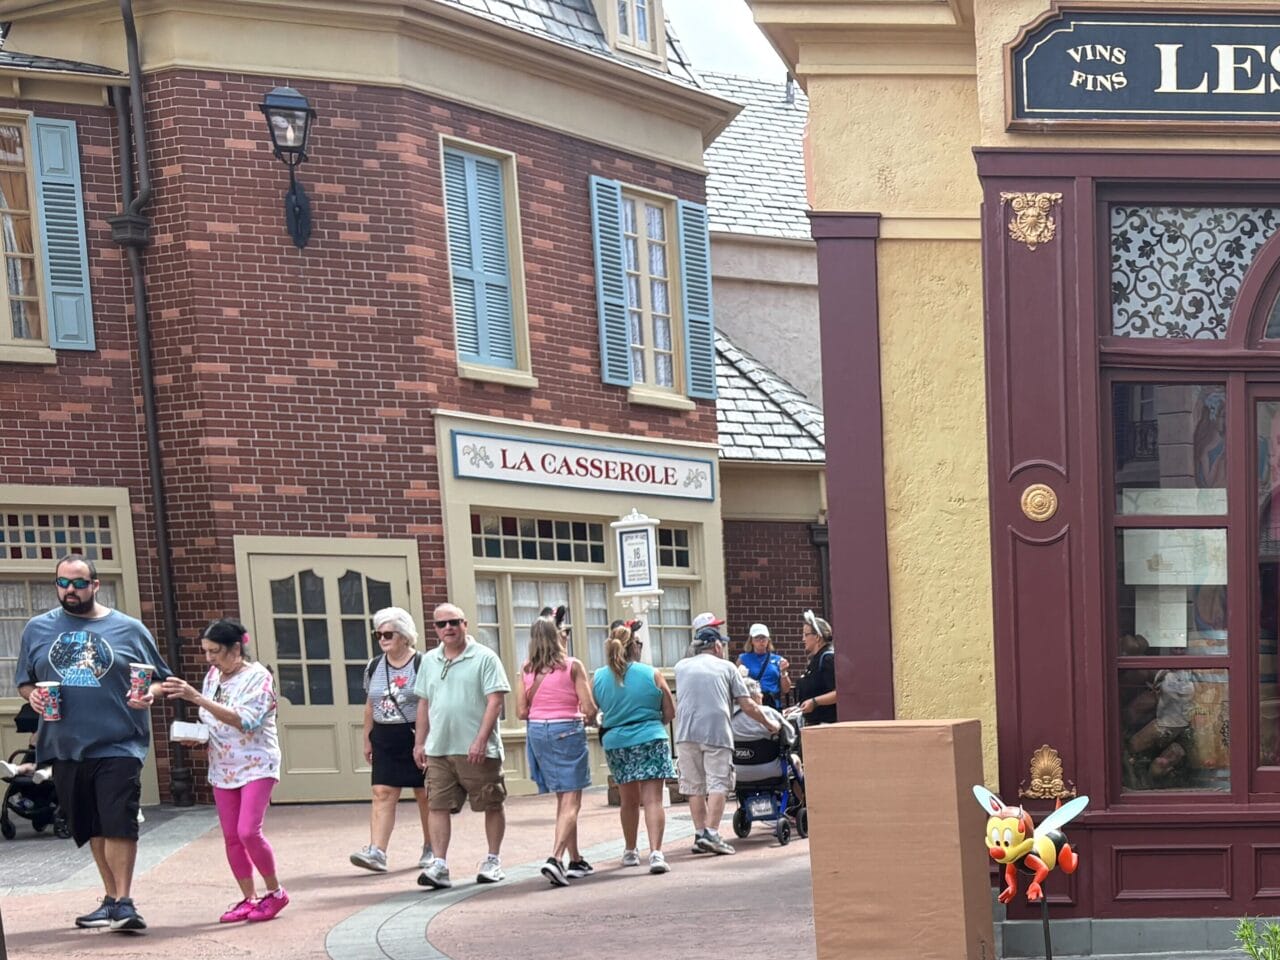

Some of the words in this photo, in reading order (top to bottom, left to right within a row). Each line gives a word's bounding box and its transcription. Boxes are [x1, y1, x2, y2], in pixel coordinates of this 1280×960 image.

[1066, 44, 1127, 65] VINS
[1069, 70, 1128, 92] FINS
[500, 448, 536, 473] LA
[540, 452, 679, 486] CASSEROLE
